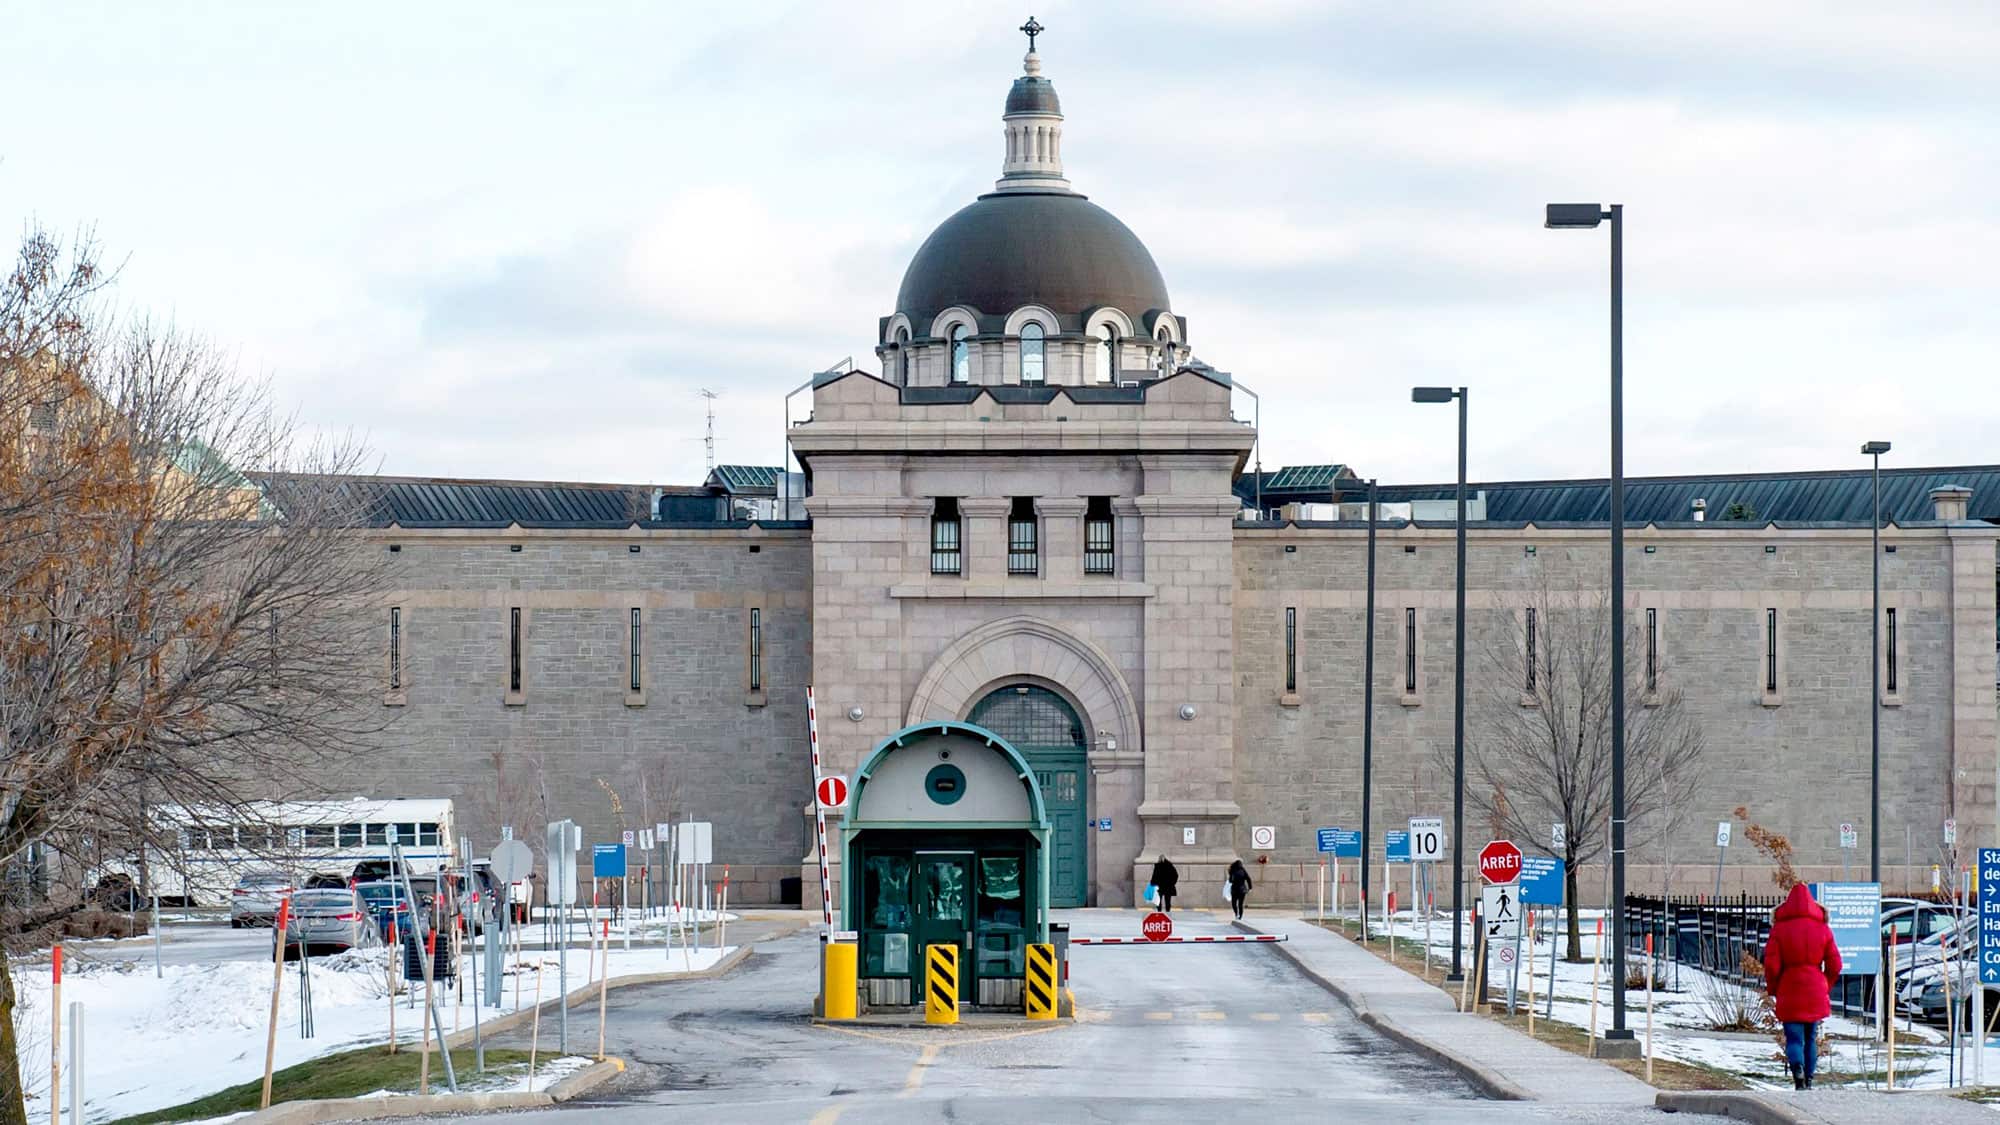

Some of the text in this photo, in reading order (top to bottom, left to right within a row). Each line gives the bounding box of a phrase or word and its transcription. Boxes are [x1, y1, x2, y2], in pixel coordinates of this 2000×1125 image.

[1415, 832, 1437, 855] 10
[1482, 853, 1520, 870] ARRÊT
[1984, 867, 2000, 880] de
[1143, 921, 1170, 933] ARRÊT
